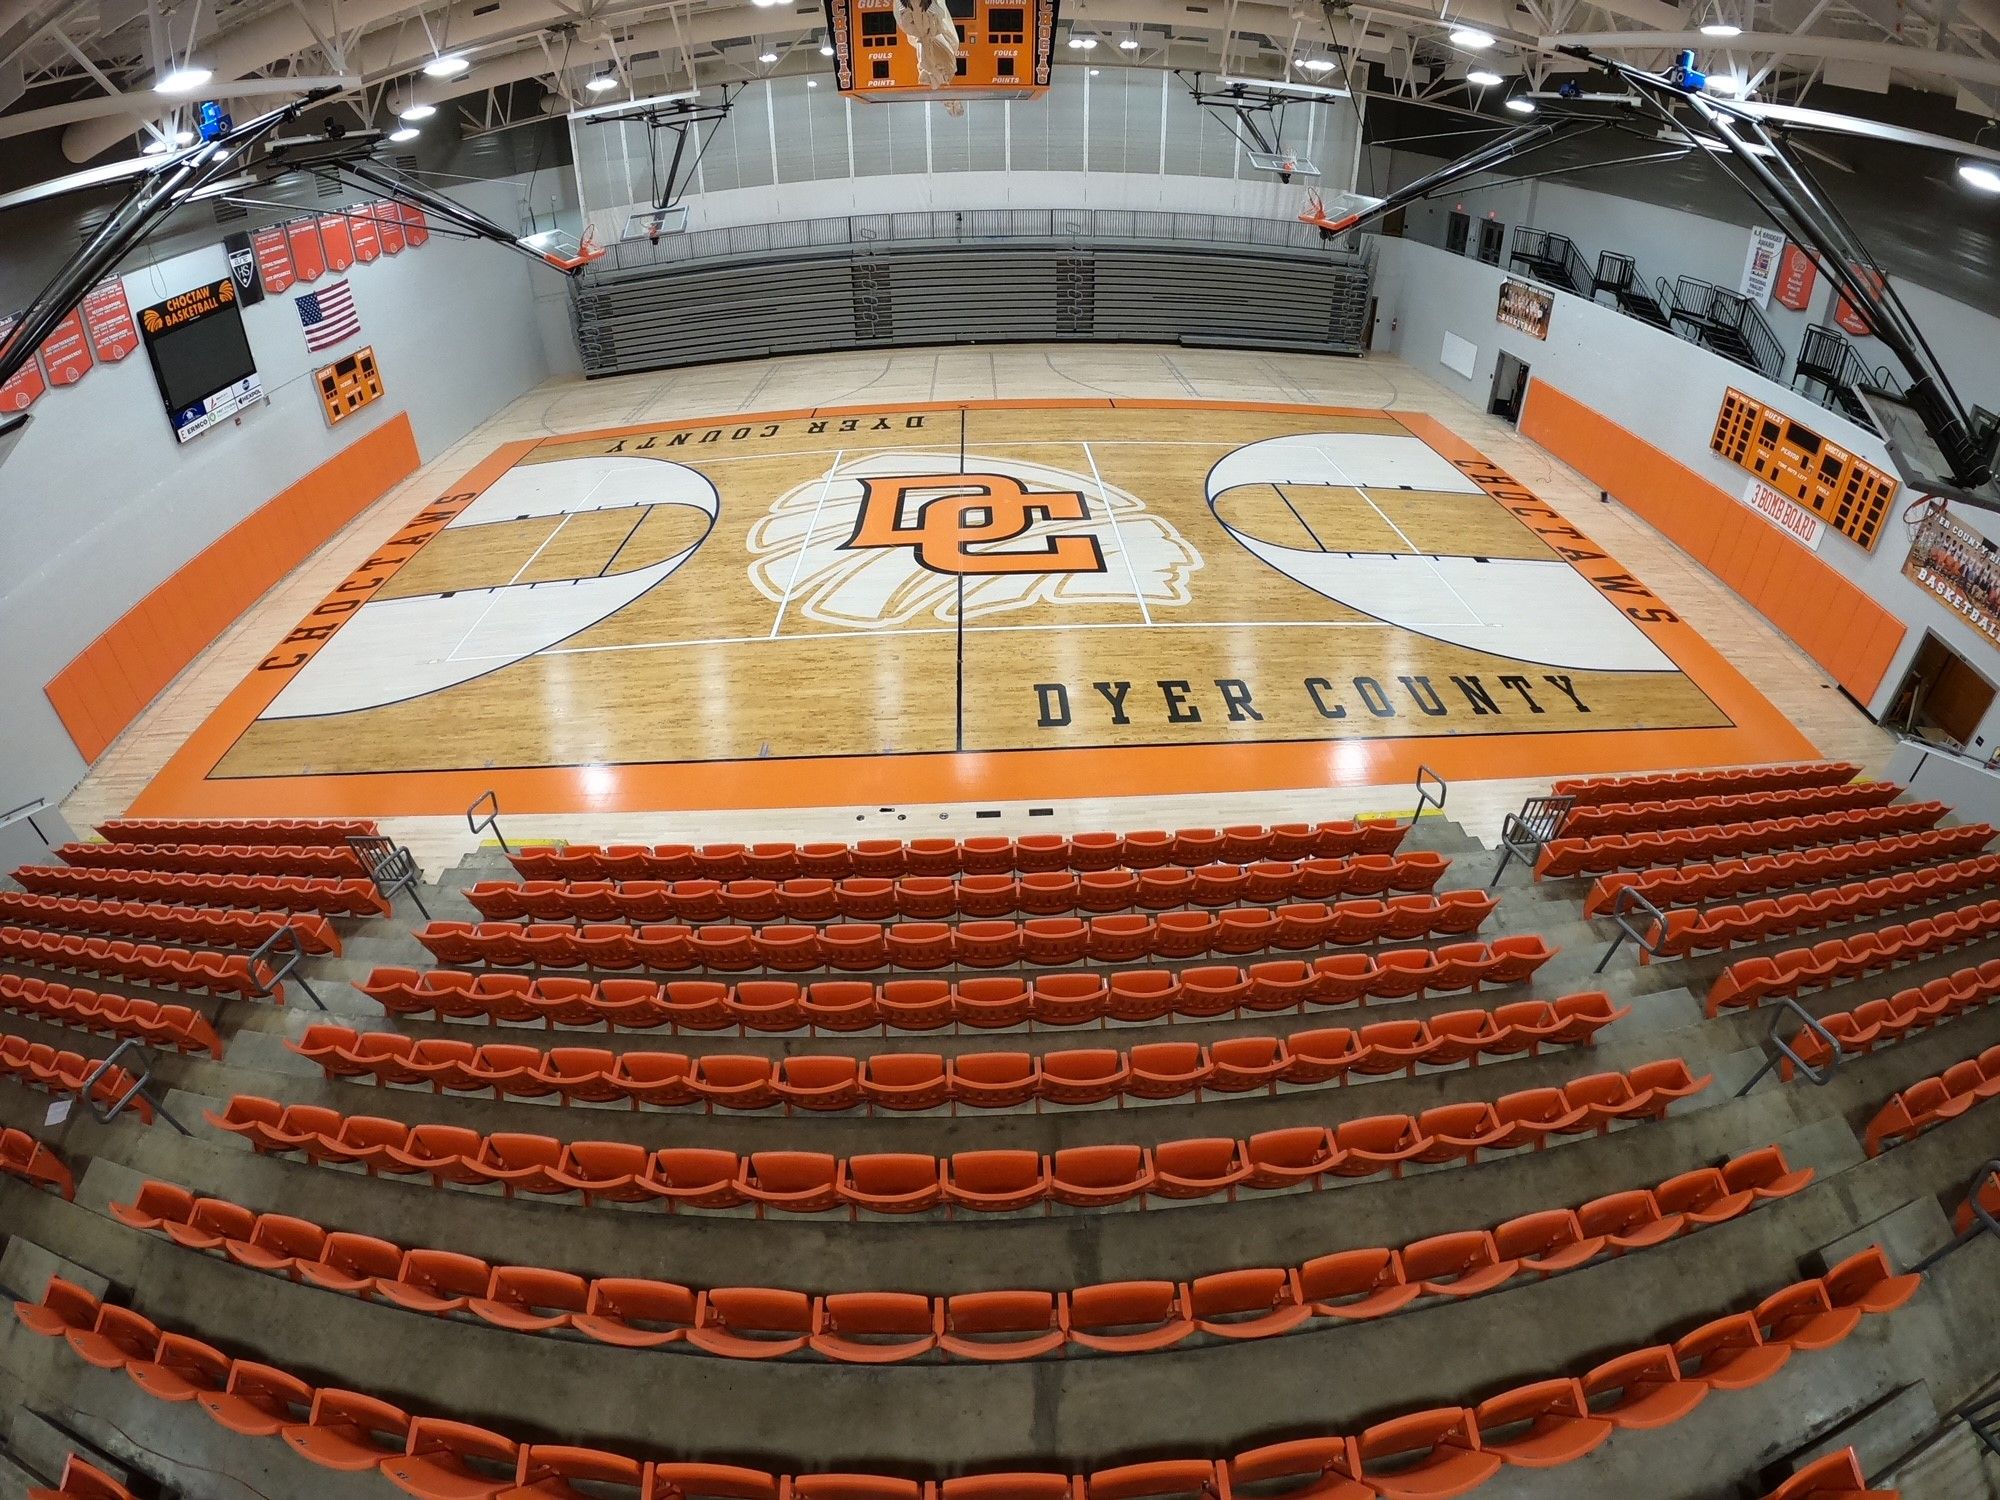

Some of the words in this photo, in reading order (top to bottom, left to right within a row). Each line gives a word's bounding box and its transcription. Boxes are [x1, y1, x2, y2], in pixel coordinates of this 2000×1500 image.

[858, 0, 891, 8] GUES
[868, 52, 893, 60] FOULS
[237, 264, 250, 278] HS
[166, 286, 210, 312] CHOCTAW
[165, 297, 219, 327] BASKETBALL
[241, 389, 262, 402] HEXPOL
[807, 416, 924, 433] DYER
[1764, 410, 1785, 425] GUEST
[187, 419, 208, 435] ERMCO
[605, 425, 780, 453] COUNTY
[1780, 446, 1800, 461] PERIOD
[1824, 443, 1849, 462] CHOCTAWS
[1797, 471, 1808, 481] LEFT
[1816, 485, 1831, 496] FOULS
[1751, 484, 1762, 504] 3
[1757, 488, 1784, 521] BOMB
[1781, 504, 1817, 542] BOARD
[834, 473, 1108, 576] DC
[1927, 508, 1950, 529] DER
[1952, 525, 1989, 554] COUNTY
[1454, 459, 1680, 624] CHOCTAWS
[257, 492, 477, 672] CHOCTAWS
[1033, 677, 1264, 728] DYER
[1303, 675, 1593, 719] COUNTY
